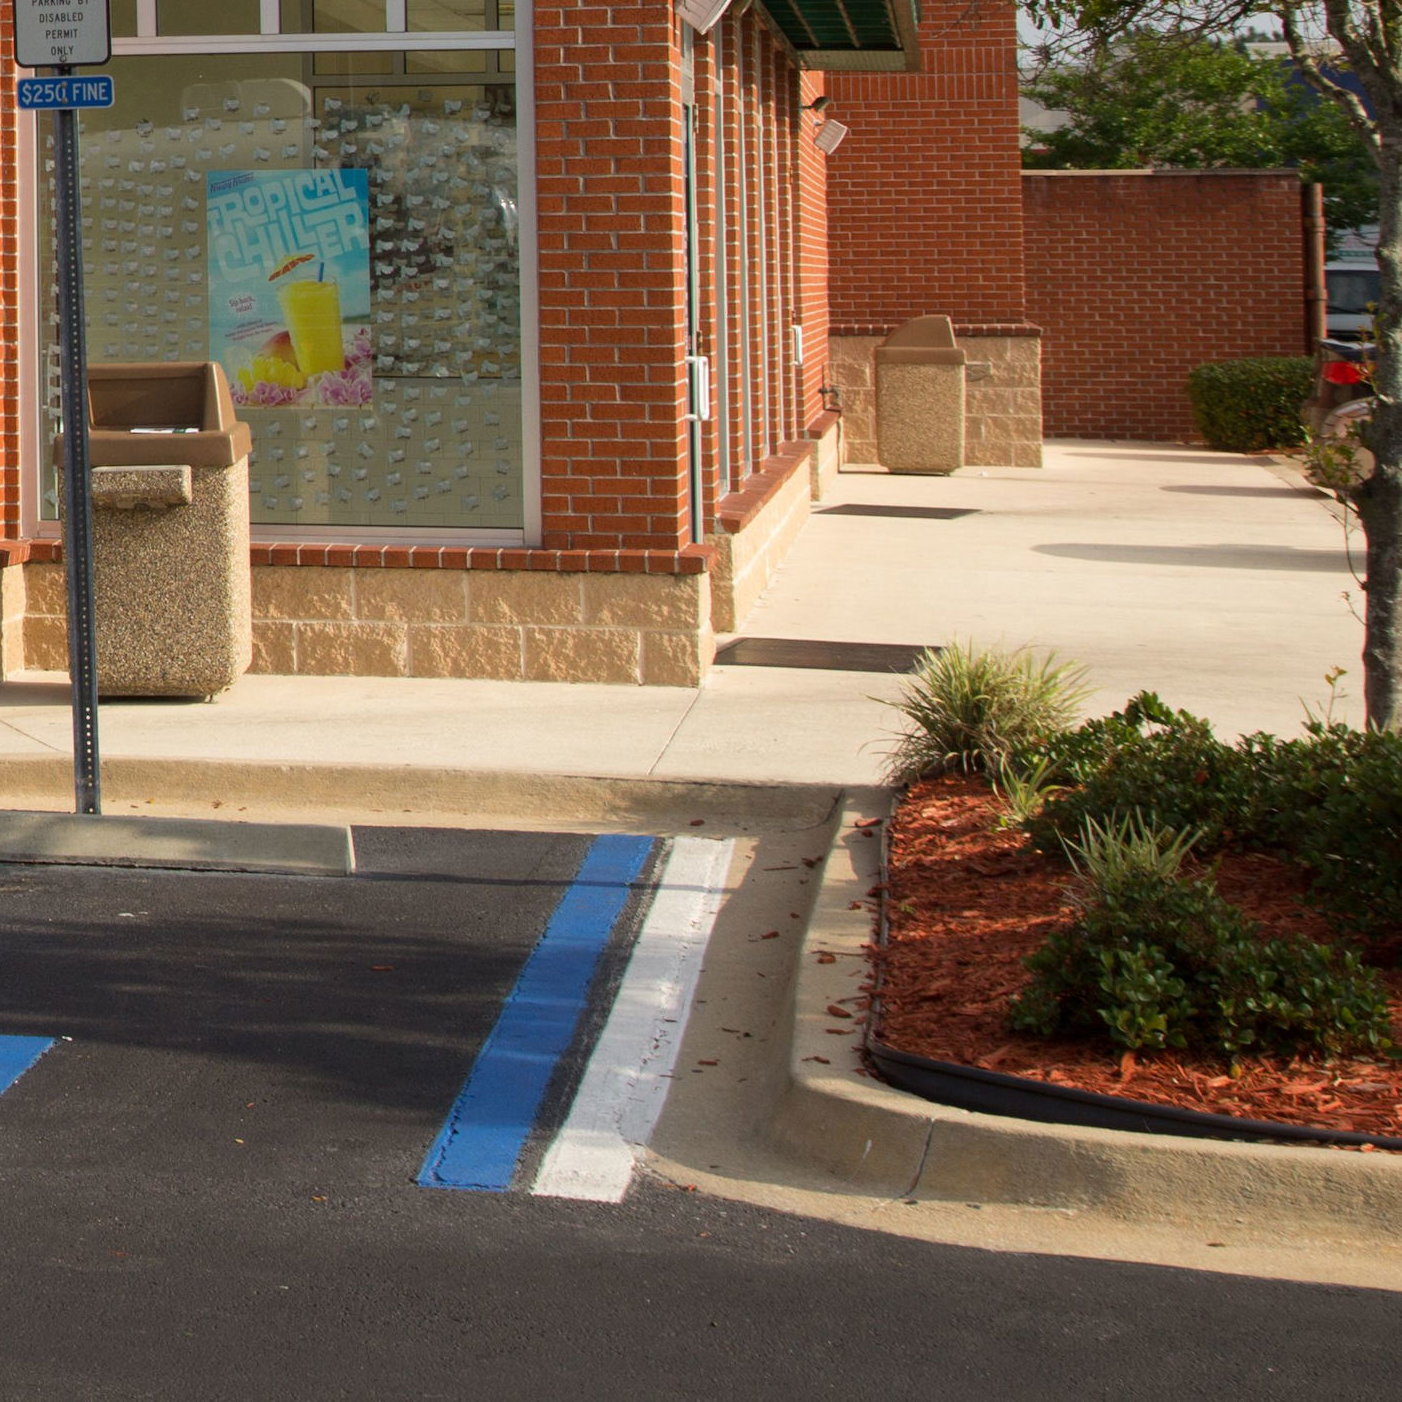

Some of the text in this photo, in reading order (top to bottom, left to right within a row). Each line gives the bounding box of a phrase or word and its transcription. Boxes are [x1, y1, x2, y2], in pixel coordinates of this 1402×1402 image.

[39, 12, 84, 23] DISABLED
[45, 29, 78, 39] PERMIT
[50, 45, 74, 56] ONLY
[72, 82, 109, 102] FINE
[207, 169, 356, 235] TROPICAL
[215, 201, 370, 283] CHILLER
